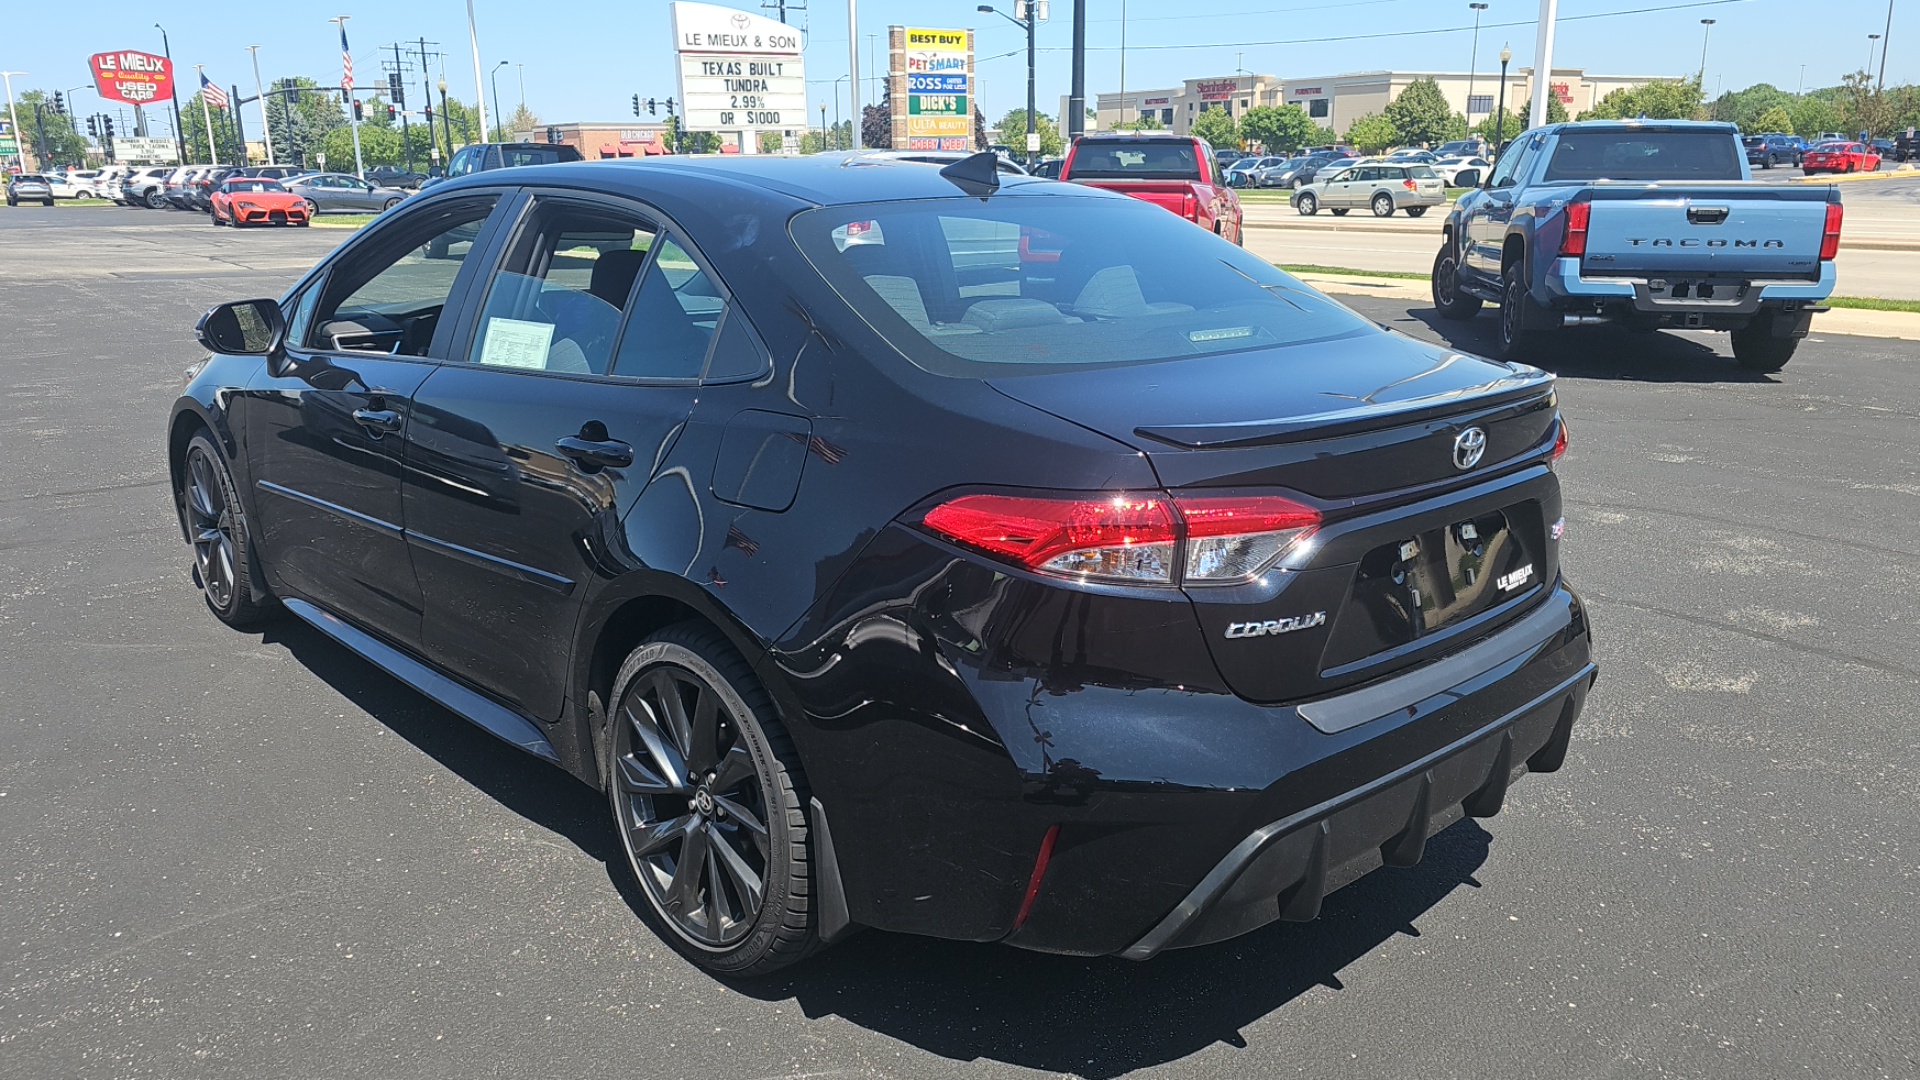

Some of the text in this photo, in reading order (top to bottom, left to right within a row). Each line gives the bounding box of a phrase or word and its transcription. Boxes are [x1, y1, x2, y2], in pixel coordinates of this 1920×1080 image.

[685, 33, 796, 49] LE MIEUX & SON
[910, 34, 962, 45] BEST BUY
[99, 53, 165, 72] LE MIEUX
[702, 62, 783, 76] TEXAS BUILT
[118, 72, 149, 82] Quality
[908, 77, 942, 90] ROSS
[115, 81, 157, 92] USED
[724, 79, 769, 92] TUNDRA
[1196, 80, 1237, 94] Steinhafels
[121, 89, 154, 101] CARS
[730, 95, 765, 109] 2.99%
[920, 96, 957, 111] DICK'S
[720, 111, 735, 125] OR
[911, 119, 966, 133] ULTA BEAUTY
[910, 138, 967, 151] HOBBY LOBBY
[1625, 237, 1784, 248] TACOMA
[1496, 563, 1533, 590] LE MIEUX
[1224, 610, 1327, 639] COROLLA
